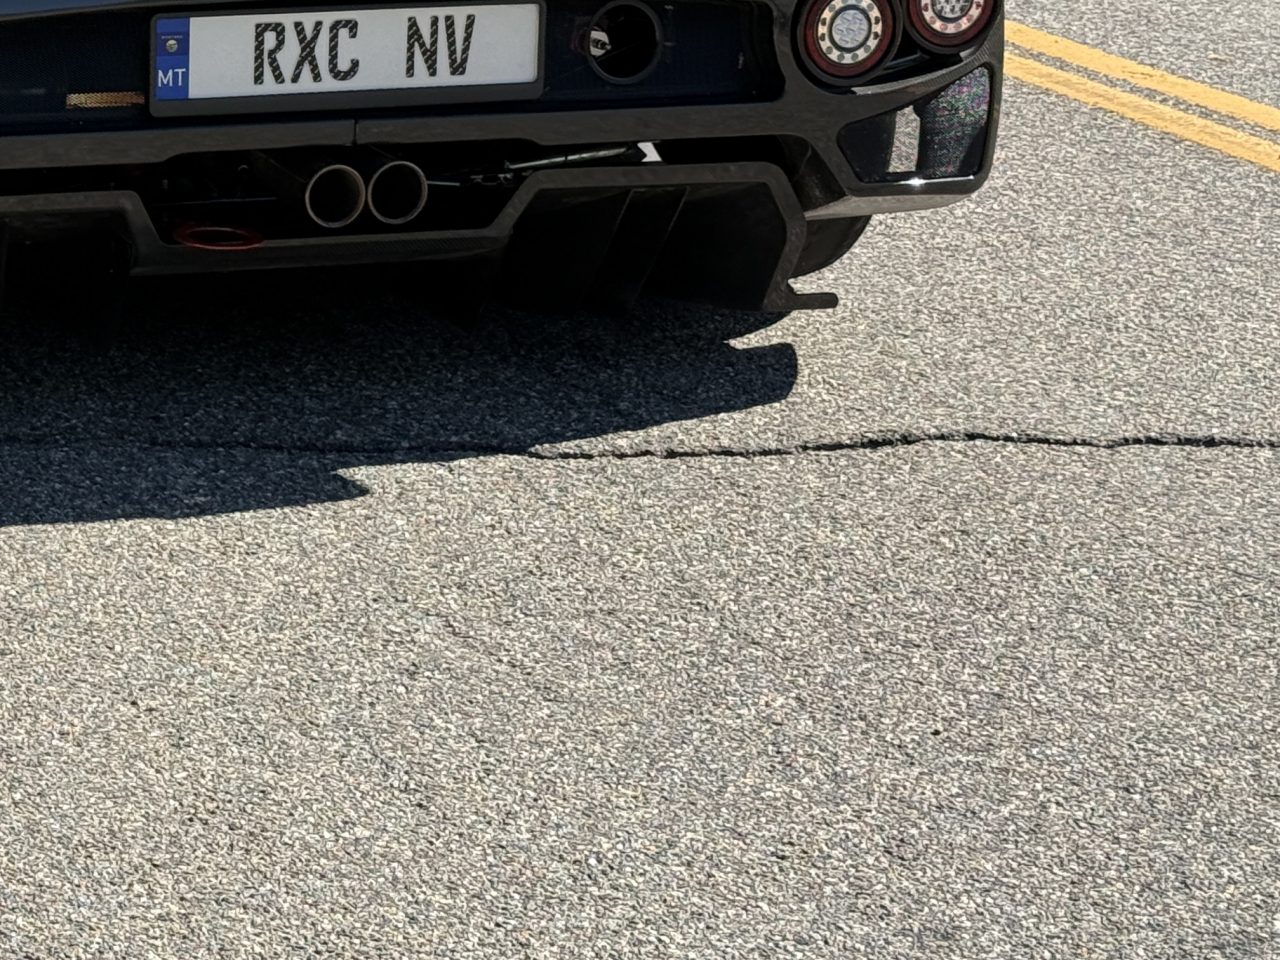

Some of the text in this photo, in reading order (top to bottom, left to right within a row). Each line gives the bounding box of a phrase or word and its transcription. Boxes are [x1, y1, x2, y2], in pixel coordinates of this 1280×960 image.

[253, 14, 476, 85] RXC NV
[158, 68, 186, 87] MT
